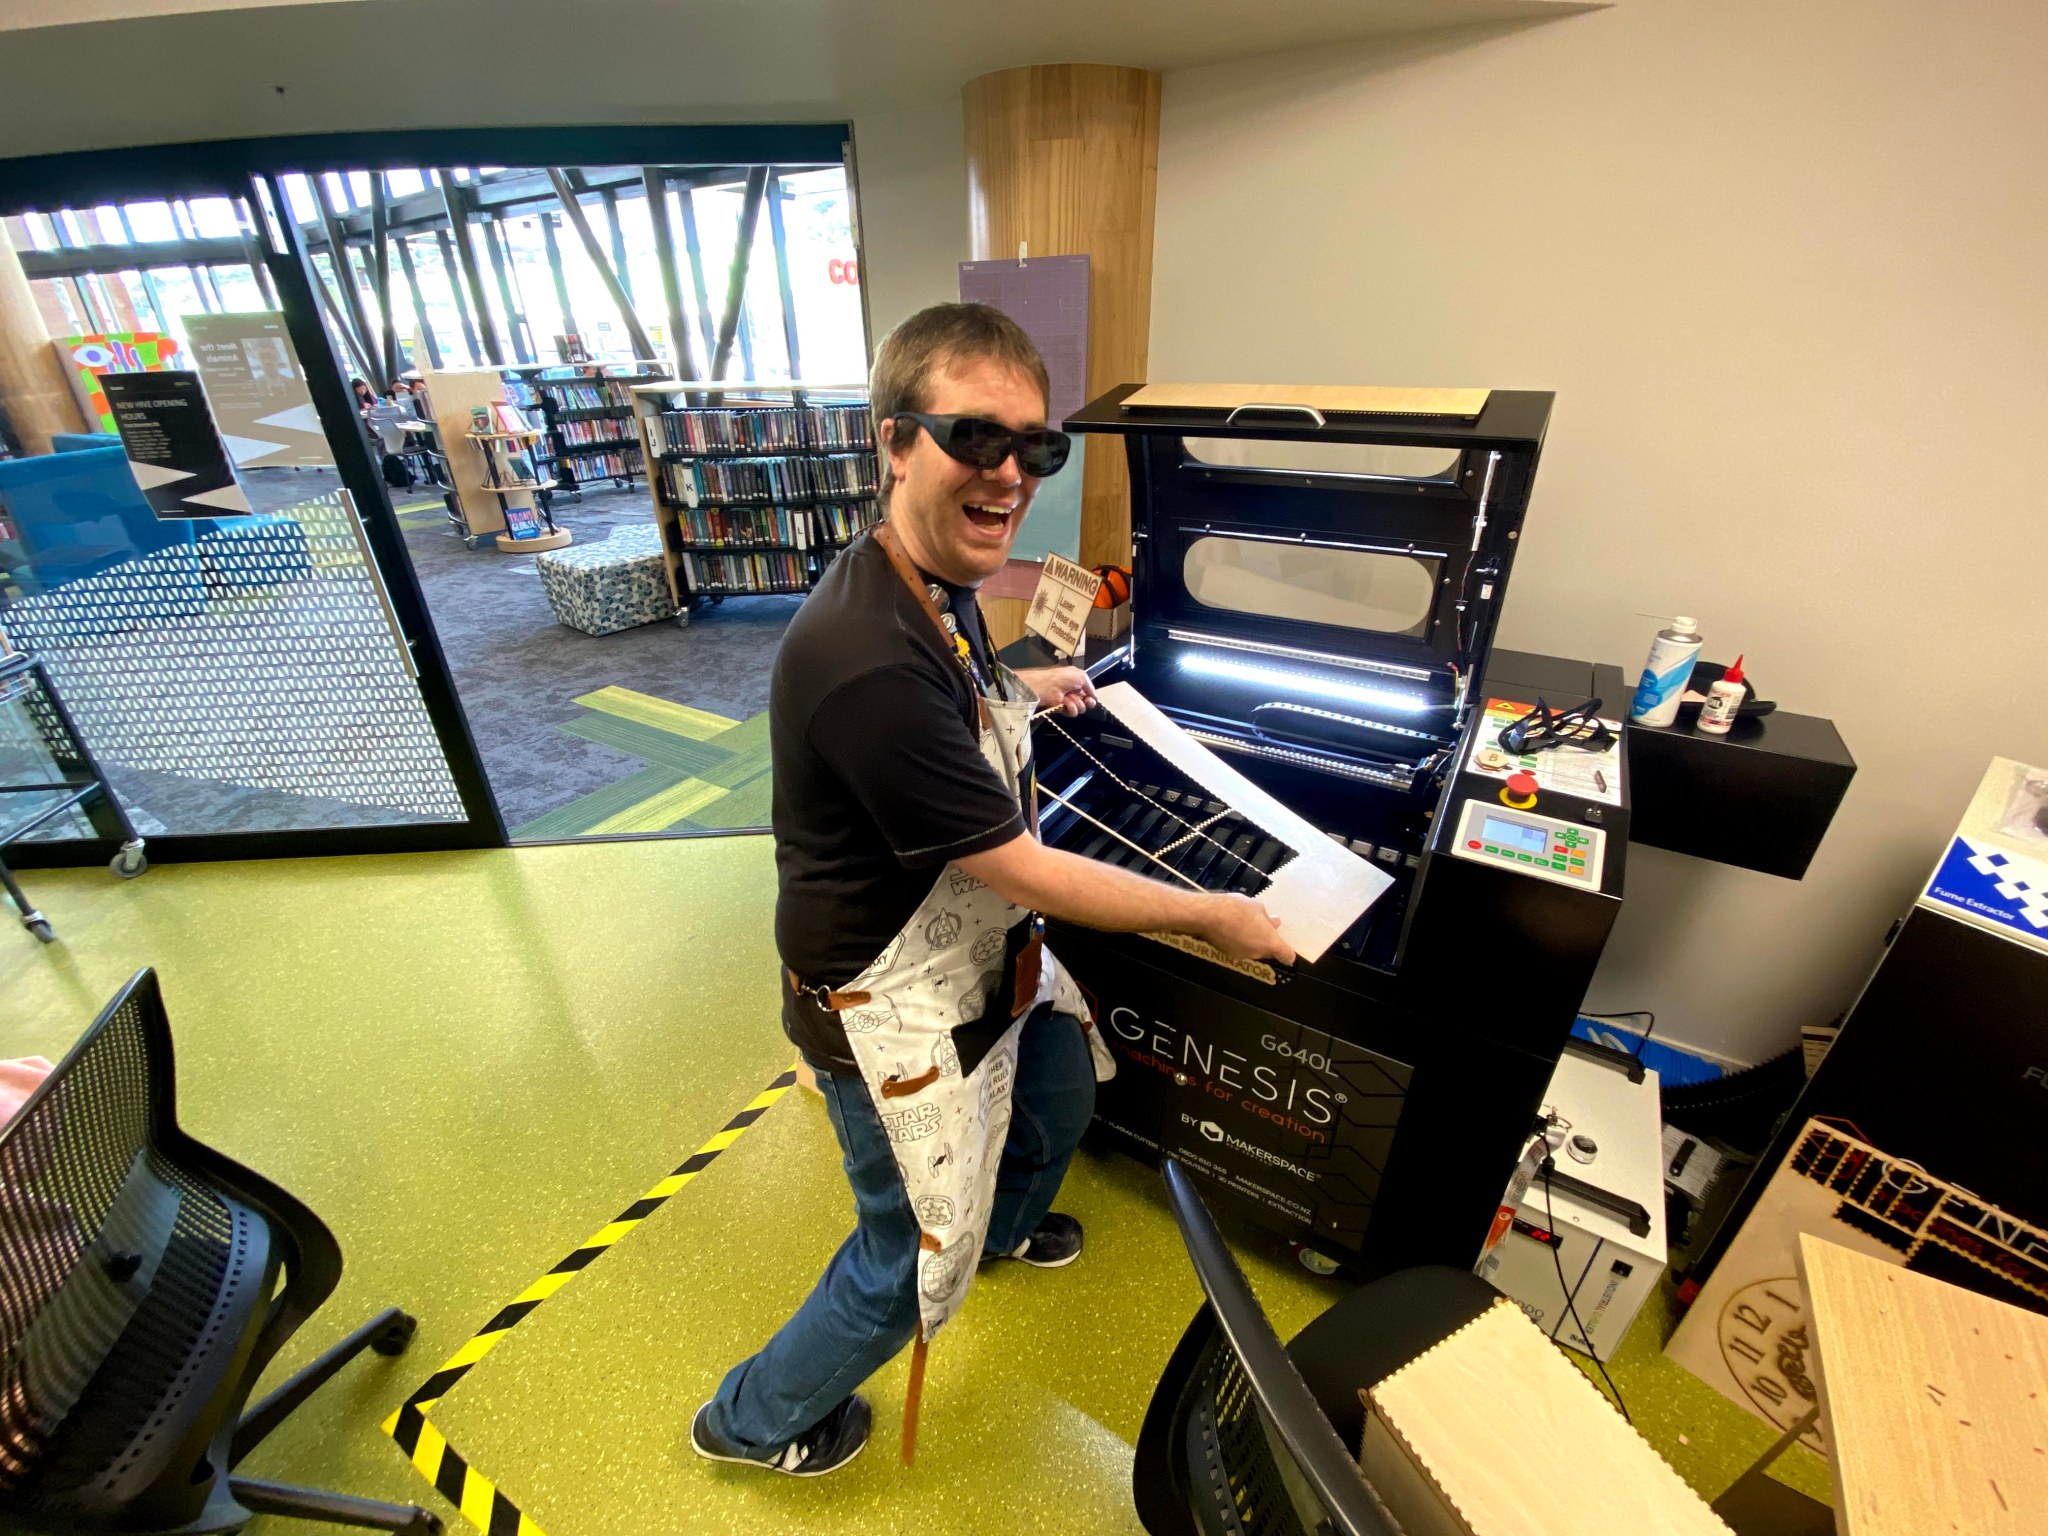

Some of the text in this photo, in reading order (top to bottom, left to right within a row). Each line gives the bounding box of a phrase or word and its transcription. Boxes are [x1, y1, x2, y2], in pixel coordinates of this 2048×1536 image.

[120, 412, 147, 420] HOURS
[135, 400, 153, 409] HIVE
[153, 399, 188, 408] OPENING
[685, 483, 693, 492] K
[1054, 561, 1098, 596] WARNING
[1060, 596, 1076, 612] Laser
[1055, 610, 1080, 631] Wear eye
[1050, 622, 1076, 646] Protection
[1934, 887, 2015, 920] Fume Extractor
[1261, 1034, 1339, 1078] G640L
[1112, 1041, 1326, 1144] machins for creation
[880, 1103, 940, 1127] STAR
[1181, 1113, 1198, 1127] BY
[1109, 1121, 1133, 1137] PLASMA
[1133, 1134, 1159, 1149] CUTTERS
[1181, 1156, 1210, 1175] ROUTERS
[1228, 1180, 1260, 1200] PRINTERS
[1267, 1200, 1312, 1225] EXTRACTION
[1733, 1304, 1772, 1334] 12
[1729, 1336, 1765, 1364] 11
[1751, 1375, 1787, 1406] 10
